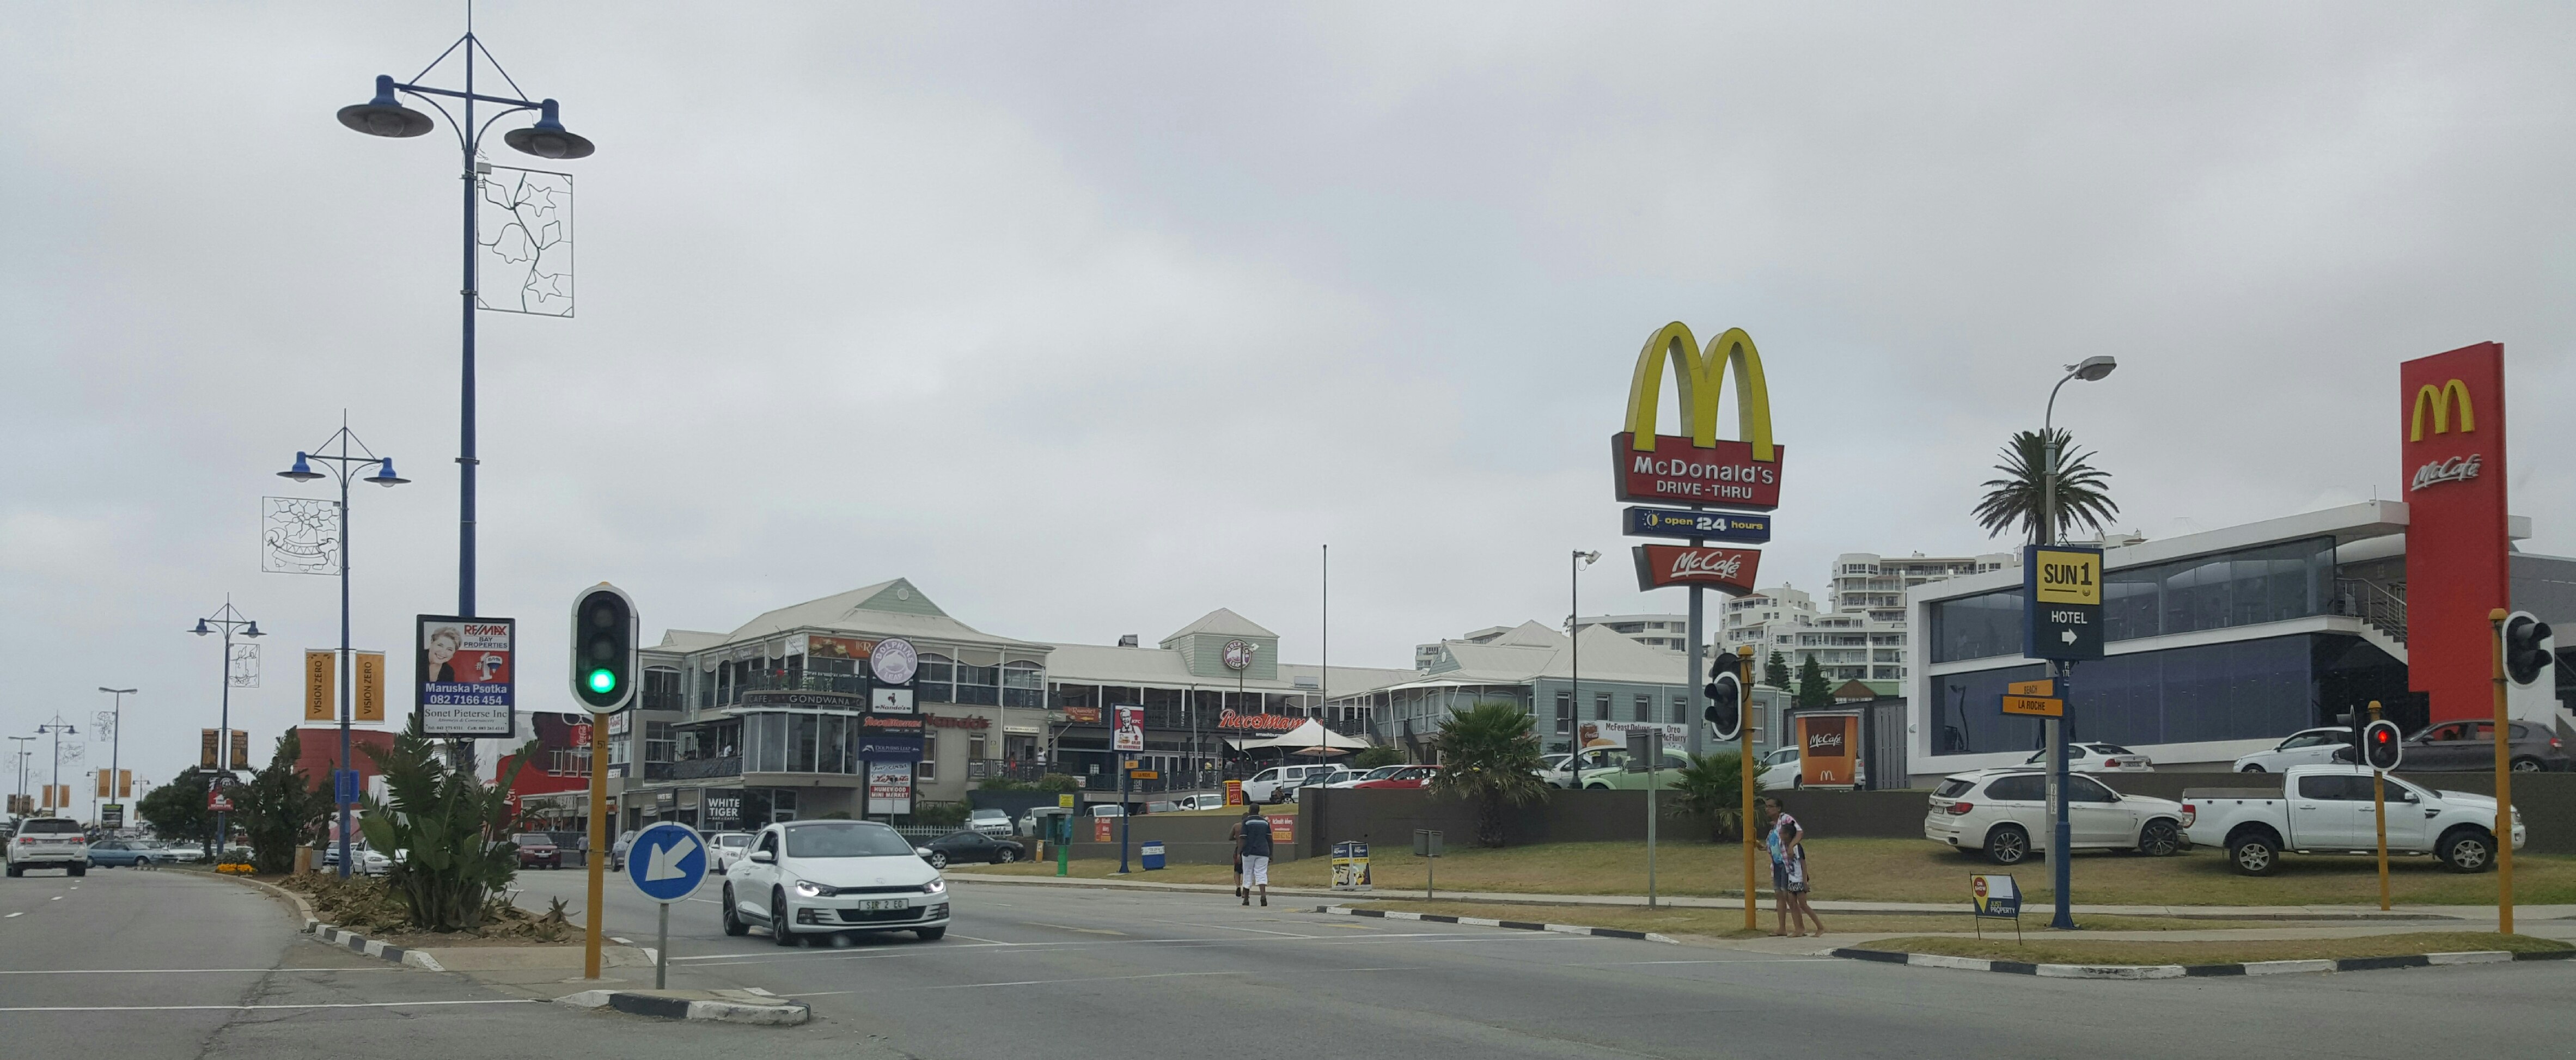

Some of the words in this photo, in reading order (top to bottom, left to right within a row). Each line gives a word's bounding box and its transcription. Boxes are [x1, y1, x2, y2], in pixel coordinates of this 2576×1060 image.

[1633, 456, 1774, 485] McDonald's
[1664, 516, 1693, 526] open
[1696, 517, 1727, 531] 24
[1731, 521, 1763, 530] hours
[1670, 550, 1742, 578] McCafé
[2052, 610, 2087, 624] HOTEL
[464, 624, 507, 636] RE/MAX
[876, 641, 914, 663] DOLPHINS
[314, 660, 322, 683] ZERO
[364, 661, 372, 684] ZERO
[884, 671, 903, 681] LEAP
[425, 683, 470, 693] Maruska
[472, 684, 507, 694] Psotka
[2024, 685, 2037, 694] BEACH
[430, 695, 451, 704] 082
[454, 695, 480, 704] 7166
[482, 696, 502, 704] 454
[789, 695, 850, 706] GONDWANA
[2018, 700, 2025, 709] LA
[2026, 701, 2046, 710] ROCHE
[425, 709, 451, 718] Sonet
[454, 709, 490, 718] Pieterse
[493, 709, 508, 718] Inc
[1667, 725, 1681, 733] Oreo
[1809, 733, 1842, 748] McCafé
[708, 798, 740, 807] WHITE
[709, 808, 738, 817] TIGER
[866, 901, 880, 909] SIR
